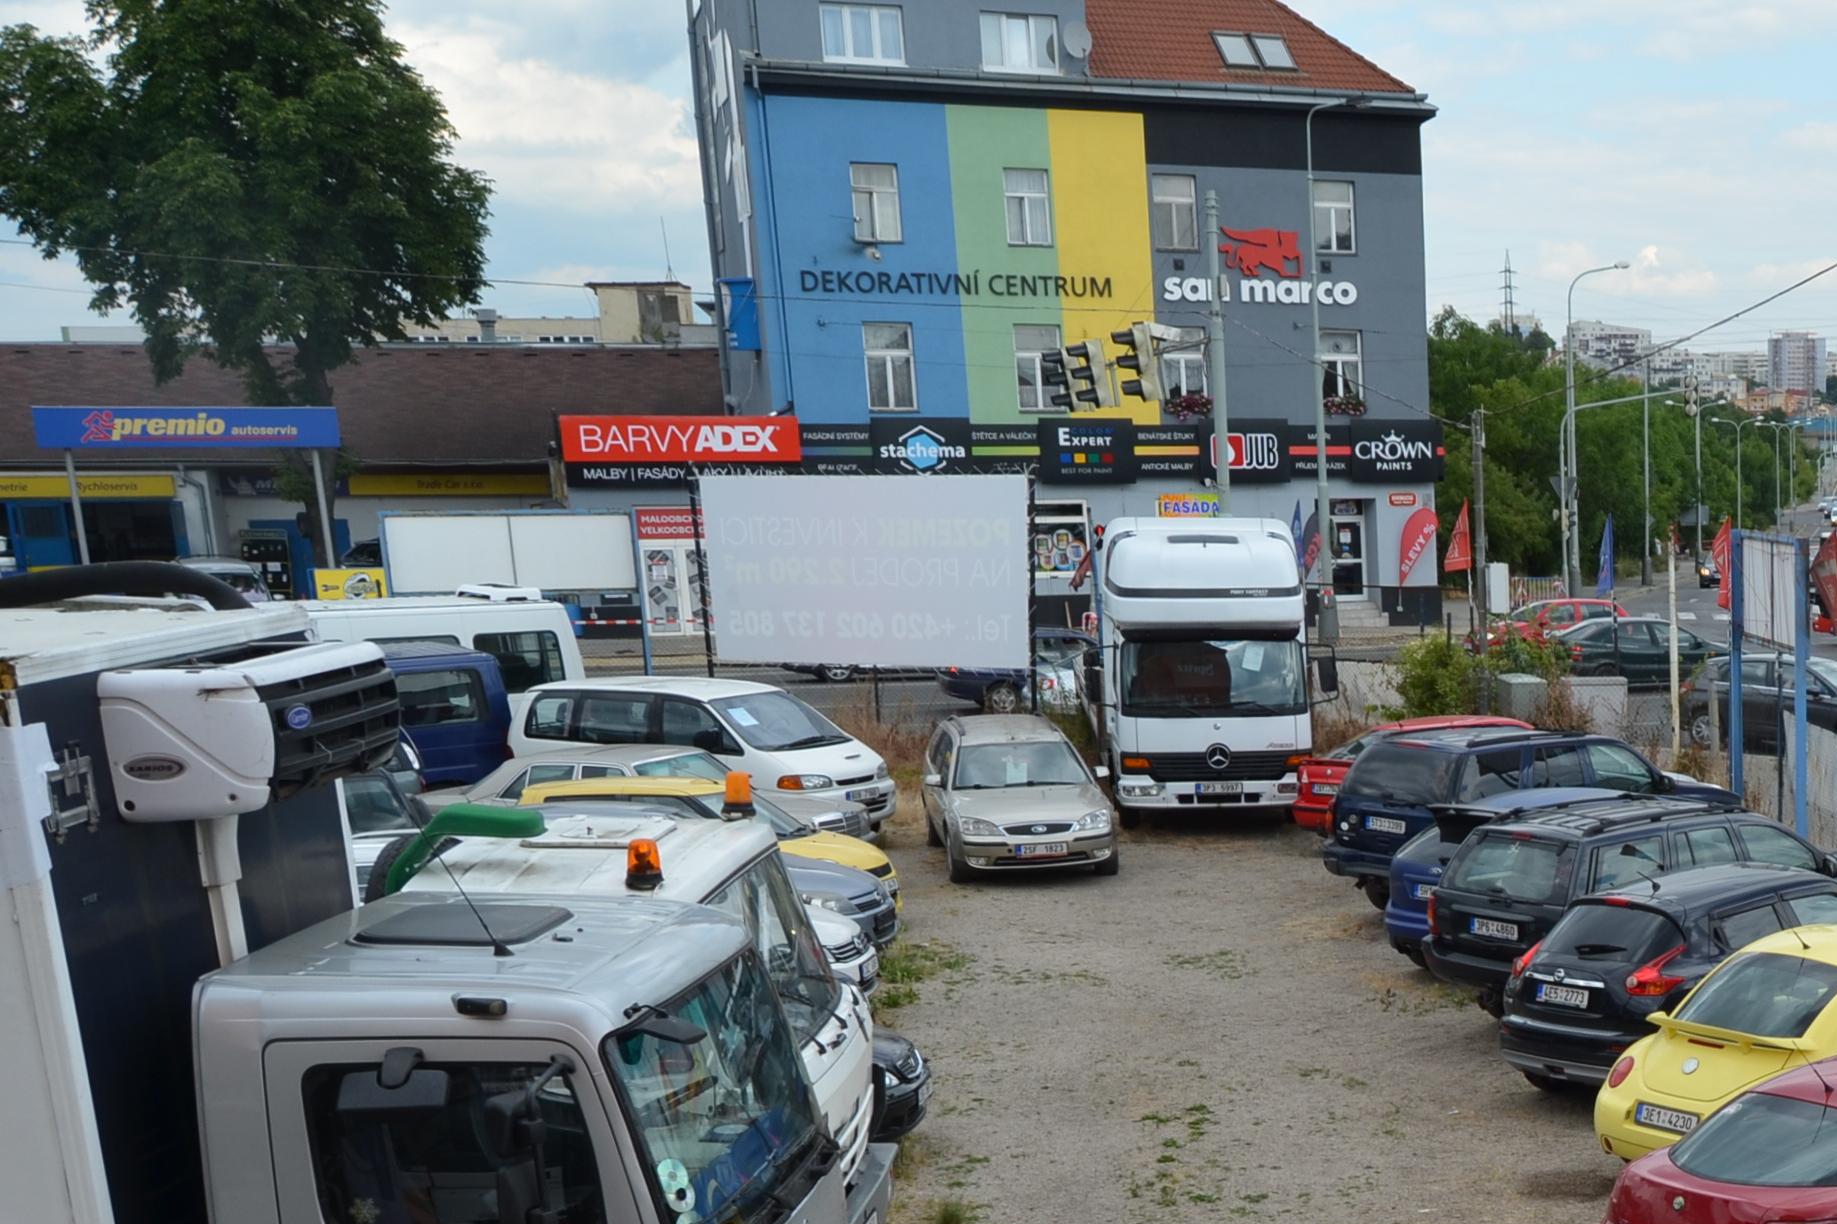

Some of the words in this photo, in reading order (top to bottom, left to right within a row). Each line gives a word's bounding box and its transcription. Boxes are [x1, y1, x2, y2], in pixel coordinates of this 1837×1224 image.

[800, 270, 980, 296] DEKORATIVNÍ
[988, 275, 1113, 299] CENTRUM
[1239, 278, 1358, 305] marco
[111, 412, 226, 441] premio
[231, 424, 298, 436] autoservis
[1058, 427, 1112, 446] EXPERT
[880, 443, 966, 459] stachema
[1246, 434, 1278, 468] JUB
[1354, 440, 1432, 460] CROWN
[583, 467, 628, 480] MALBY
[637, 465, 686, 480] FASÁDY
[1377, 461, 1412, 471] PAINTS
[1643, 1107, 1661, 1124] 3E1
[1668, 1112, 1693, 1130] 4230
